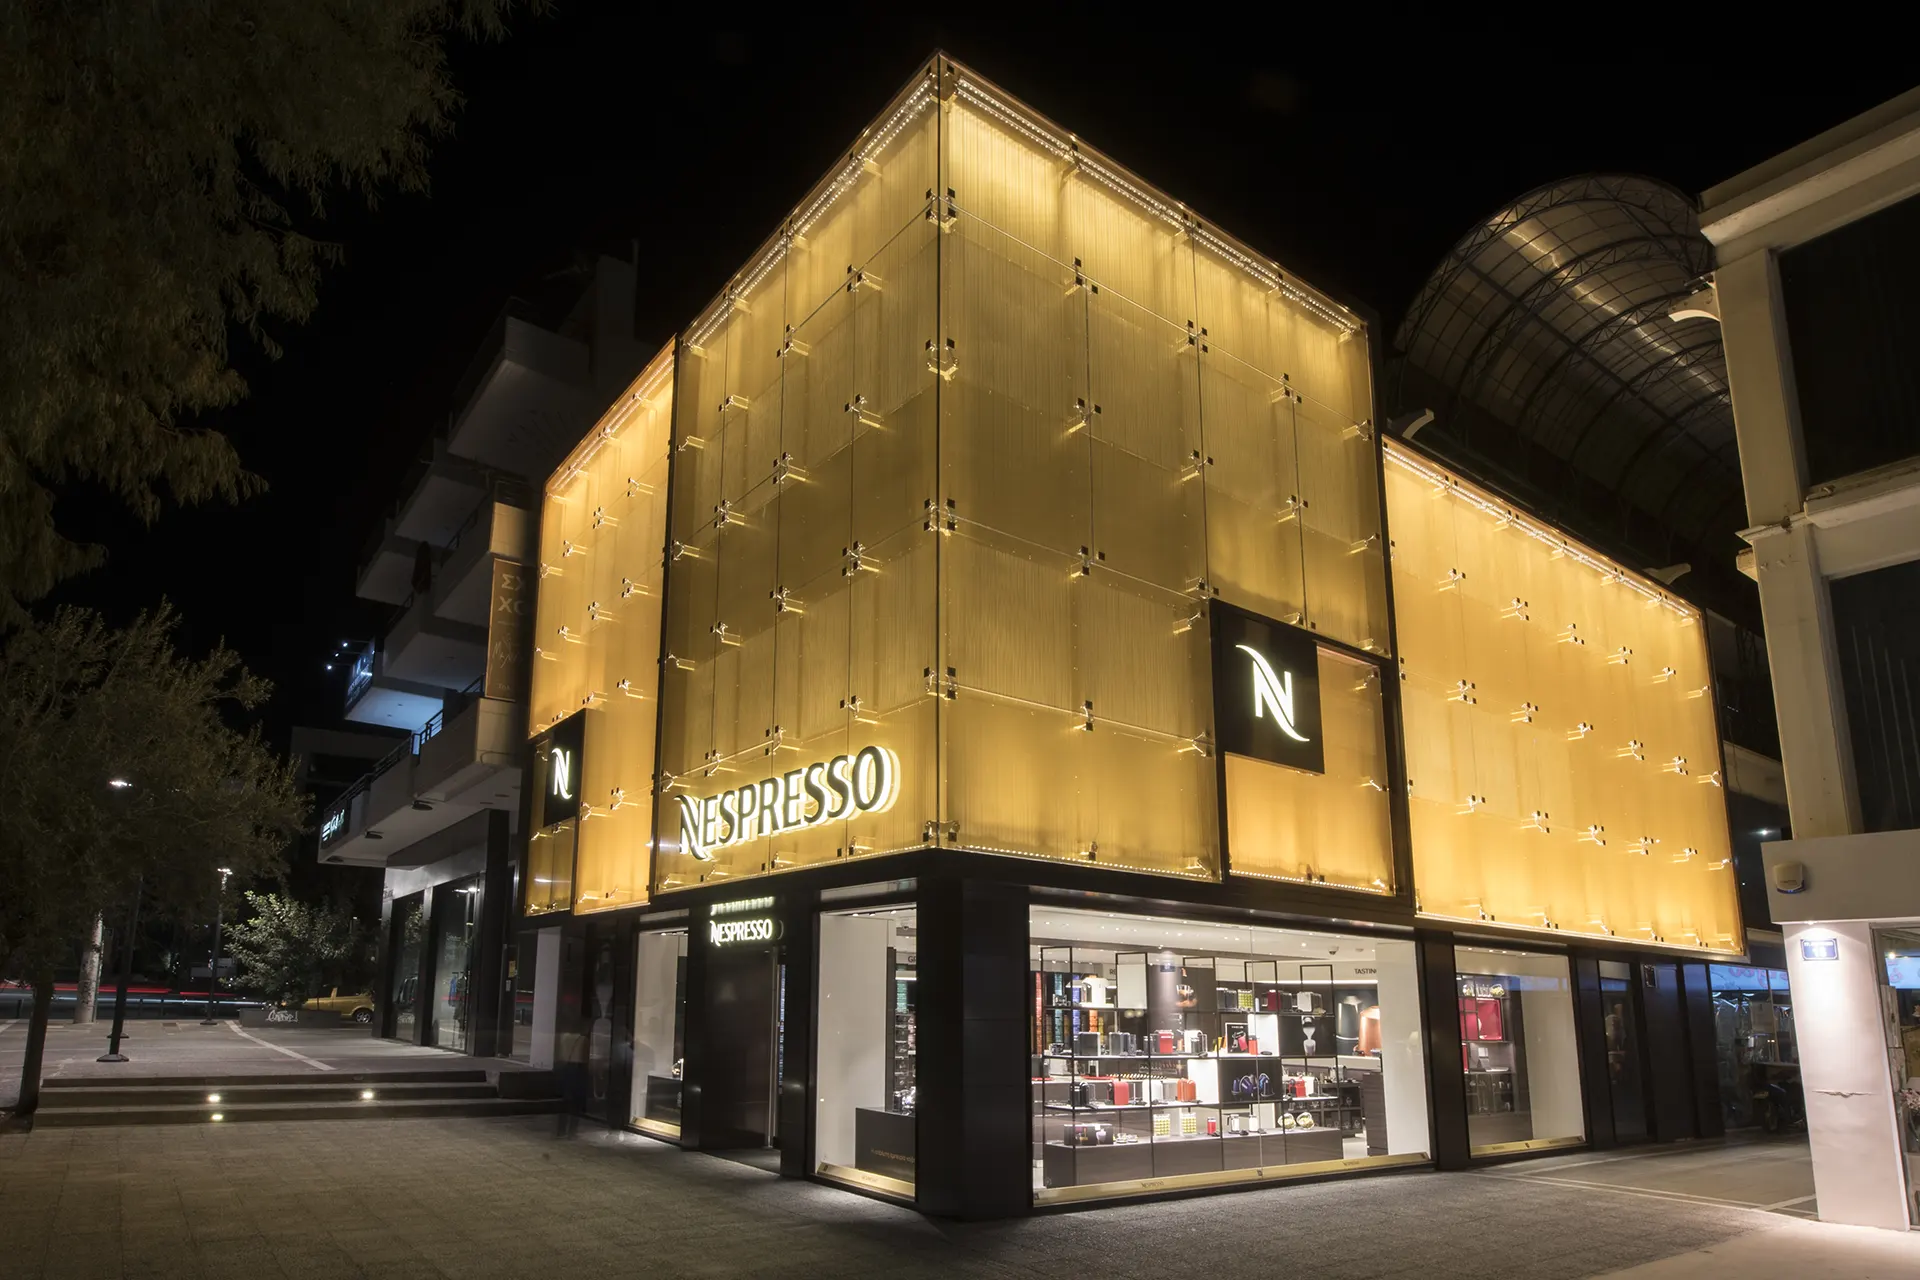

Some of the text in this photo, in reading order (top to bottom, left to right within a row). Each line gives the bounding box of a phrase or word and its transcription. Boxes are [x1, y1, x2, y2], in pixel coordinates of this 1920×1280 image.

[1236, 644, 1310, 741] N
[552, 748, 572, 799] N
[674, 745, 889, 861] NESPRESSO
[709, 919, 773, 947] NESPRESSO
[1354, 967, 1377, 975] TASTIN
